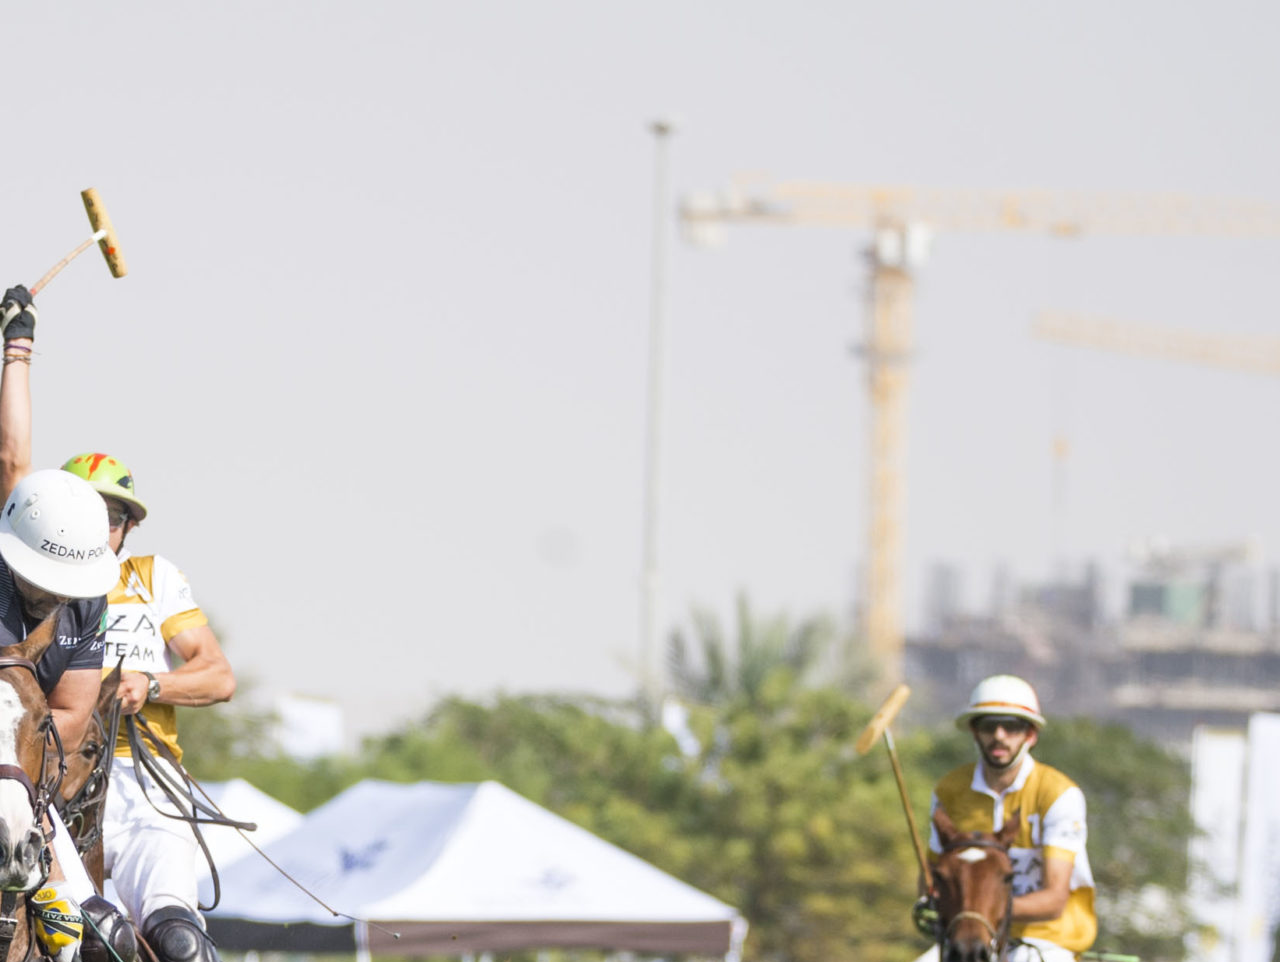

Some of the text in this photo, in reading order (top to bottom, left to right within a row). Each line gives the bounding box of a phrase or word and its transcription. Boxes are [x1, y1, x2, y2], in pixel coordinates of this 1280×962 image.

[41, 539, 108, 560] ZEDAN POL
[106, 613, 155, 636] ZA
[105, 642, 155, 662] TEAM
[1028, 814, 1039, 845] 1
